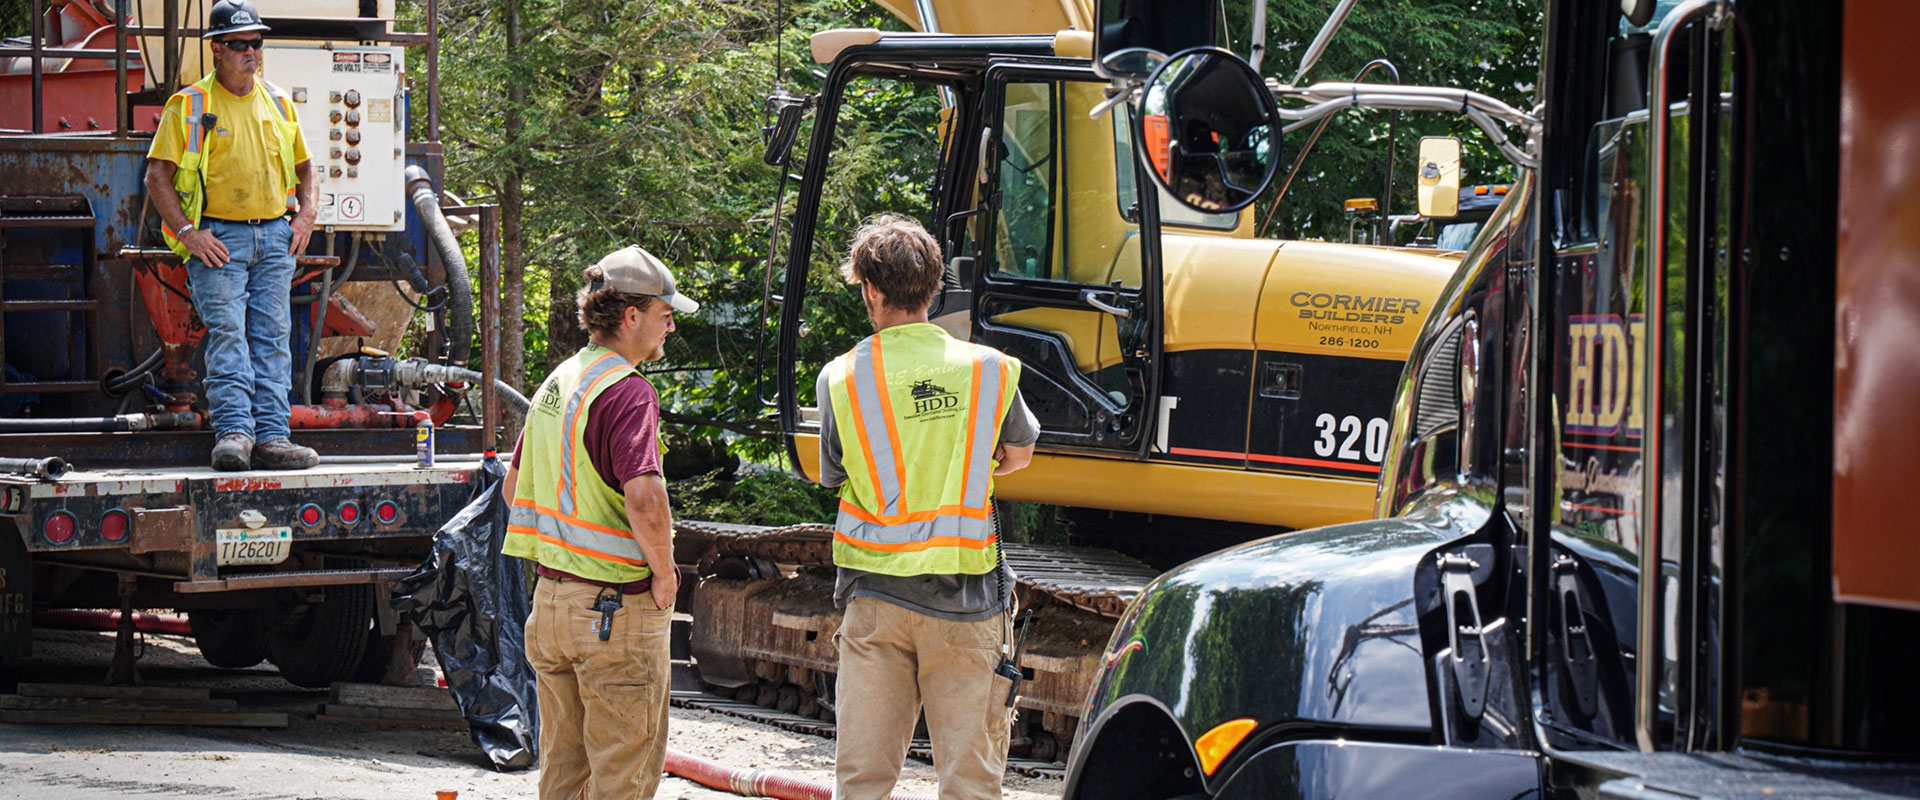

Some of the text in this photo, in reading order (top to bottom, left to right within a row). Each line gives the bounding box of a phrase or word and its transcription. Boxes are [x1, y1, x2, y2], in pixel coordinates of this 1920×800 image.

[344, 63, 361, 72] VOLTS
[1290, 292, 1421, 314] CORMIER
[1298, 309, 1405, 324] BUILDERS
[1373, 325, 1392, 335] NH
[1319, 336, 1379, 349] 286-1200
[914, 395, 958, 413] HDD
[1313, 412, 1390, 462] 320
[222, 541, 282, 559] T126201
